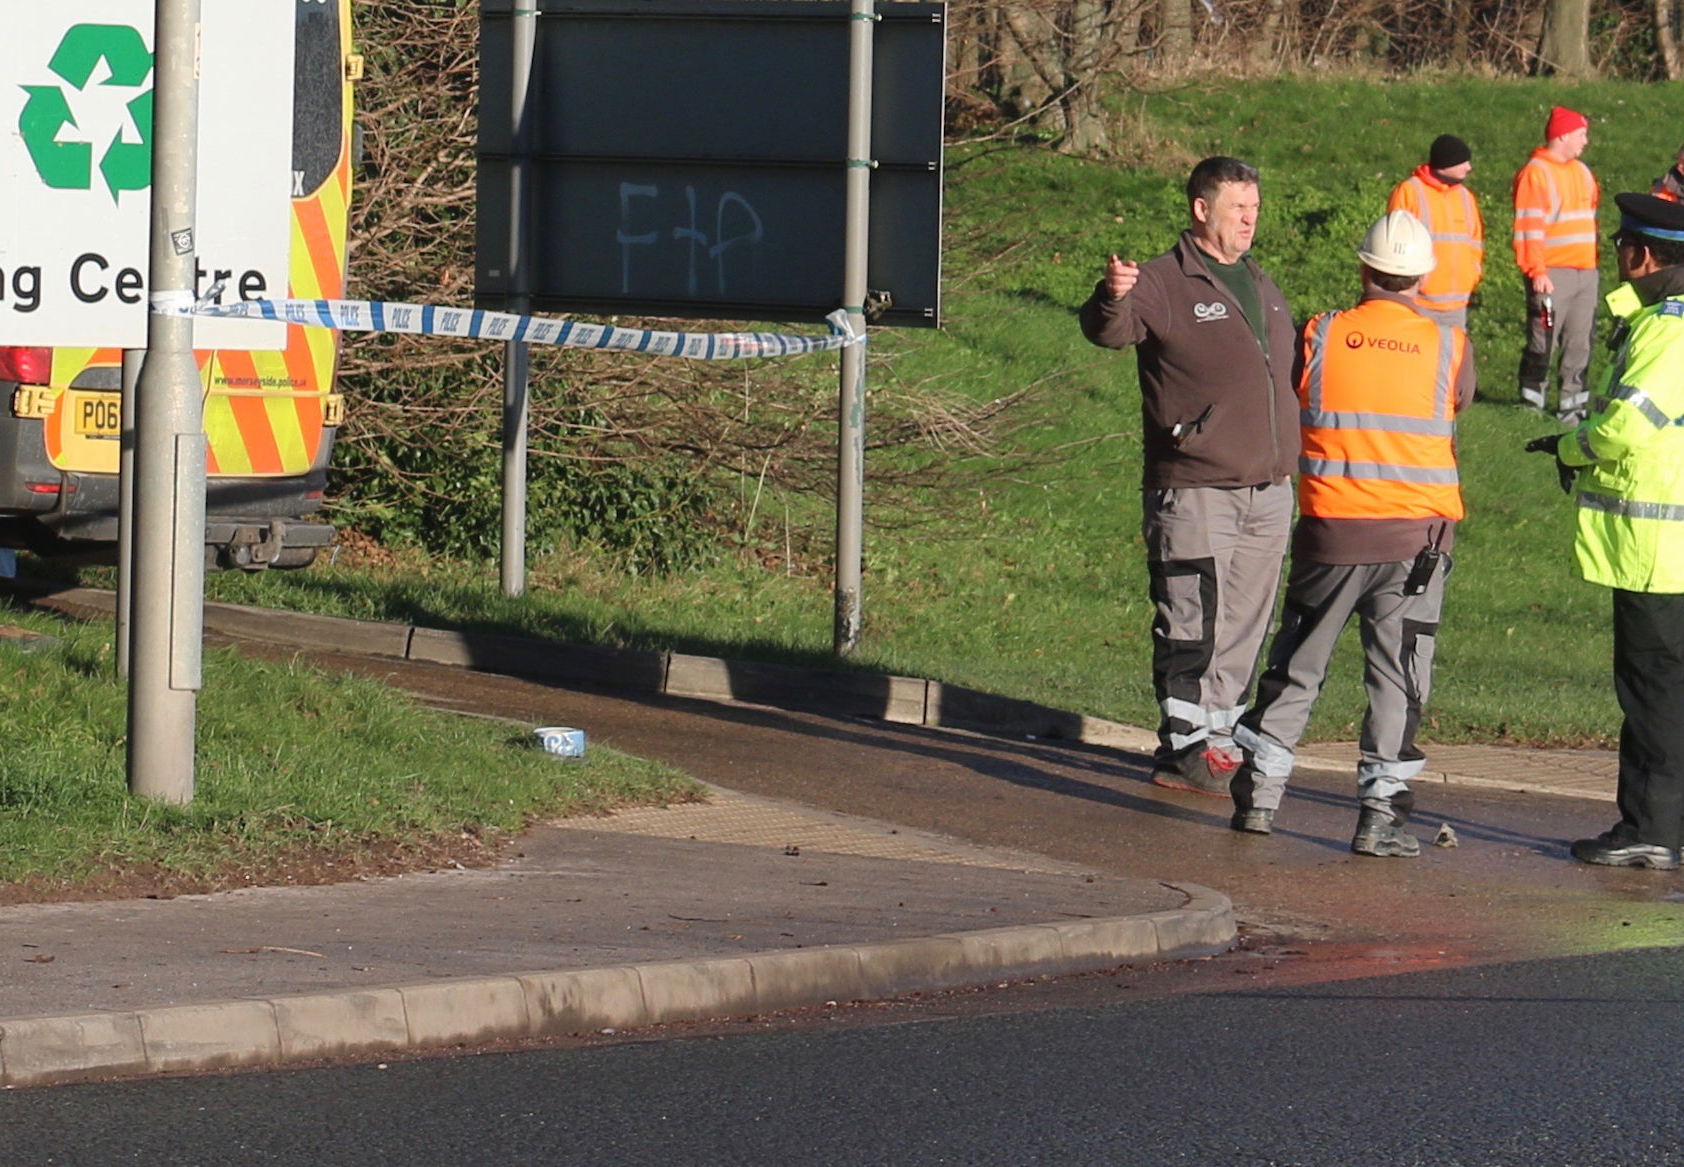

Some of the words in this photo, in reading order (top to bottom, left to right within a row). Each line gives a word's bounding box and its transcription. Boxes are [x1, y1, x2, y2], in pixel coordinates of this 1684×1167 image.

[70, 252, 268, 307] Cetre
[1367, 337, 1422, 355] VEOLIA
[82, 400, 119, 429] PO6
